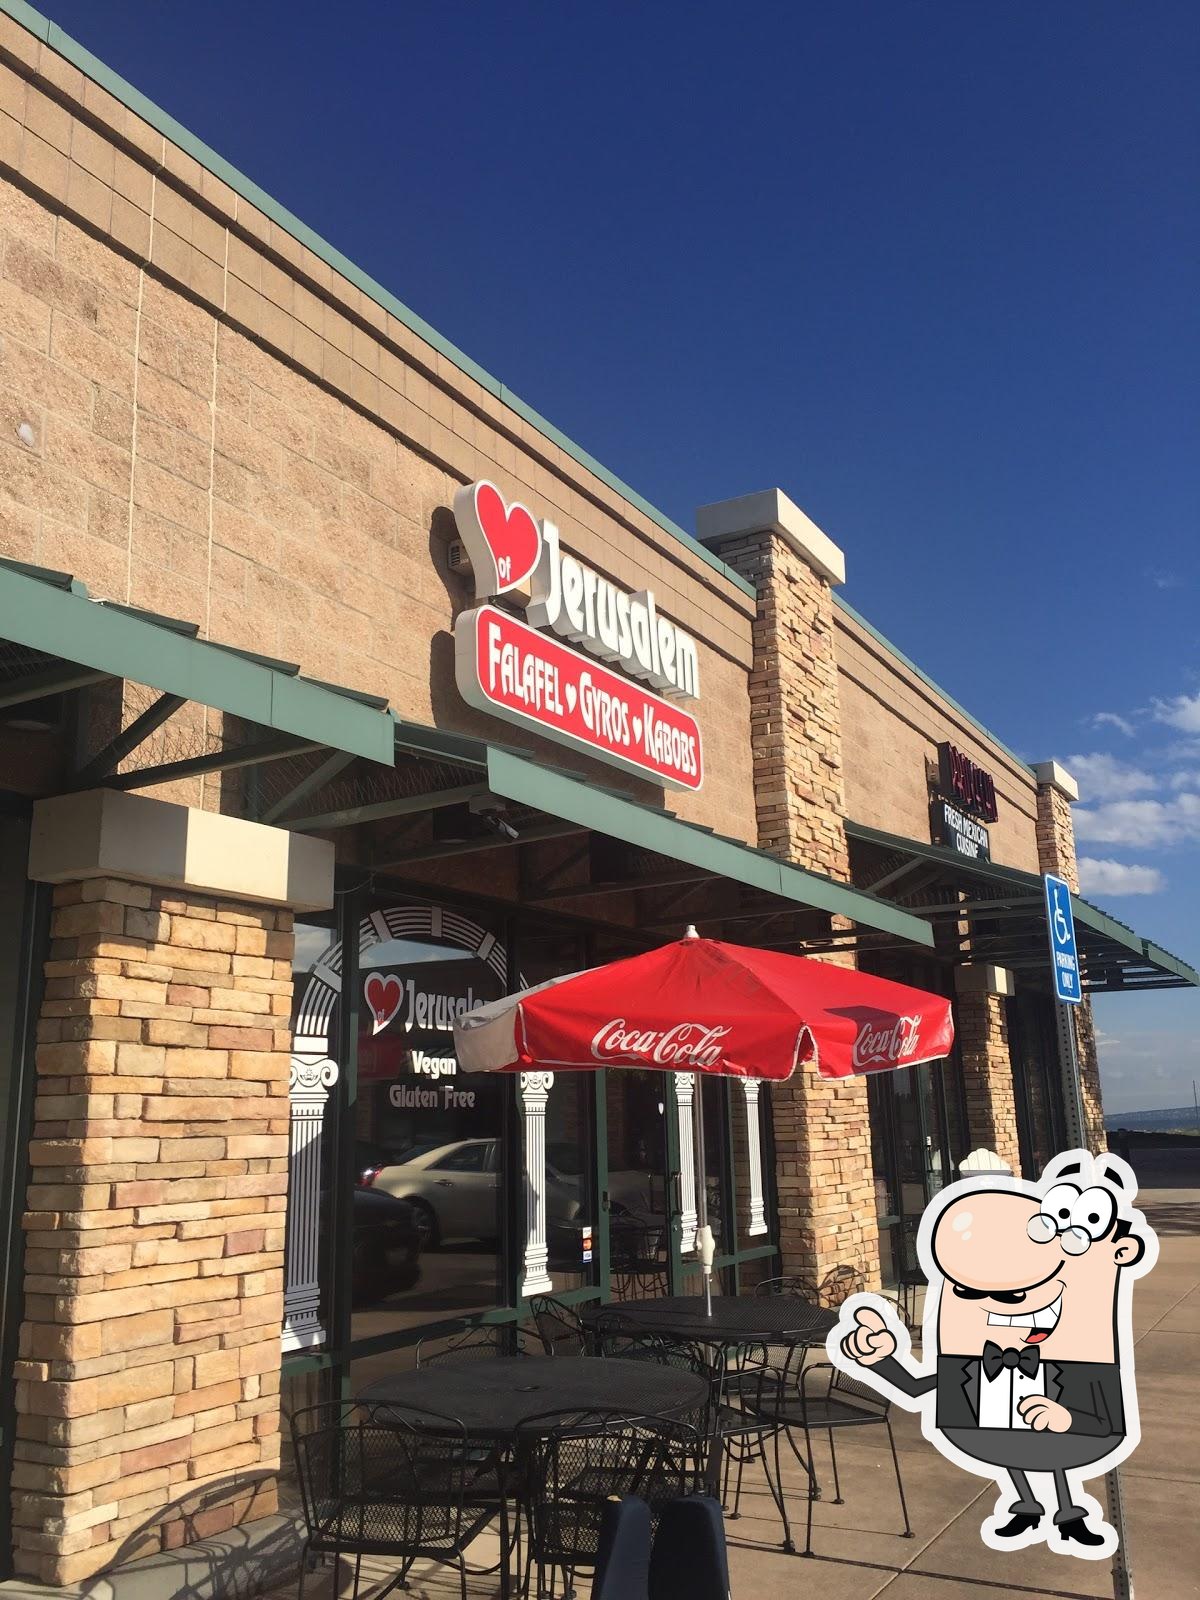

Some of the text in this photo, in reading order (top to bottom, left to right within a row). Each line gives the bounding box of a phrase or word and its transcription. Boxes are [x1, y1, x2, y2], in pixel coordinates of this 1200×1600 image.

[499, 518, 700, 700] of Jerusalem
[489, 622, 697, 777] FALAFEL GYROS KABOBS
[944, 803, 989, 849] FRESH MEXICAN
[956, 832, 979, 859] CUISINE
[1056, 951, 1075, 971] PARKING
[1061, 971, 1073, 989] ONLY
[405, 979, 492, 1034] Jerusal
[591, 1018, 732, 1067] Coca-Cola
[853, 1014, 922, 1066] Coca-Cola
[411, 1050, 457, 1079] Vegan
[389, 1084, 475, 1110] Gluten Free
